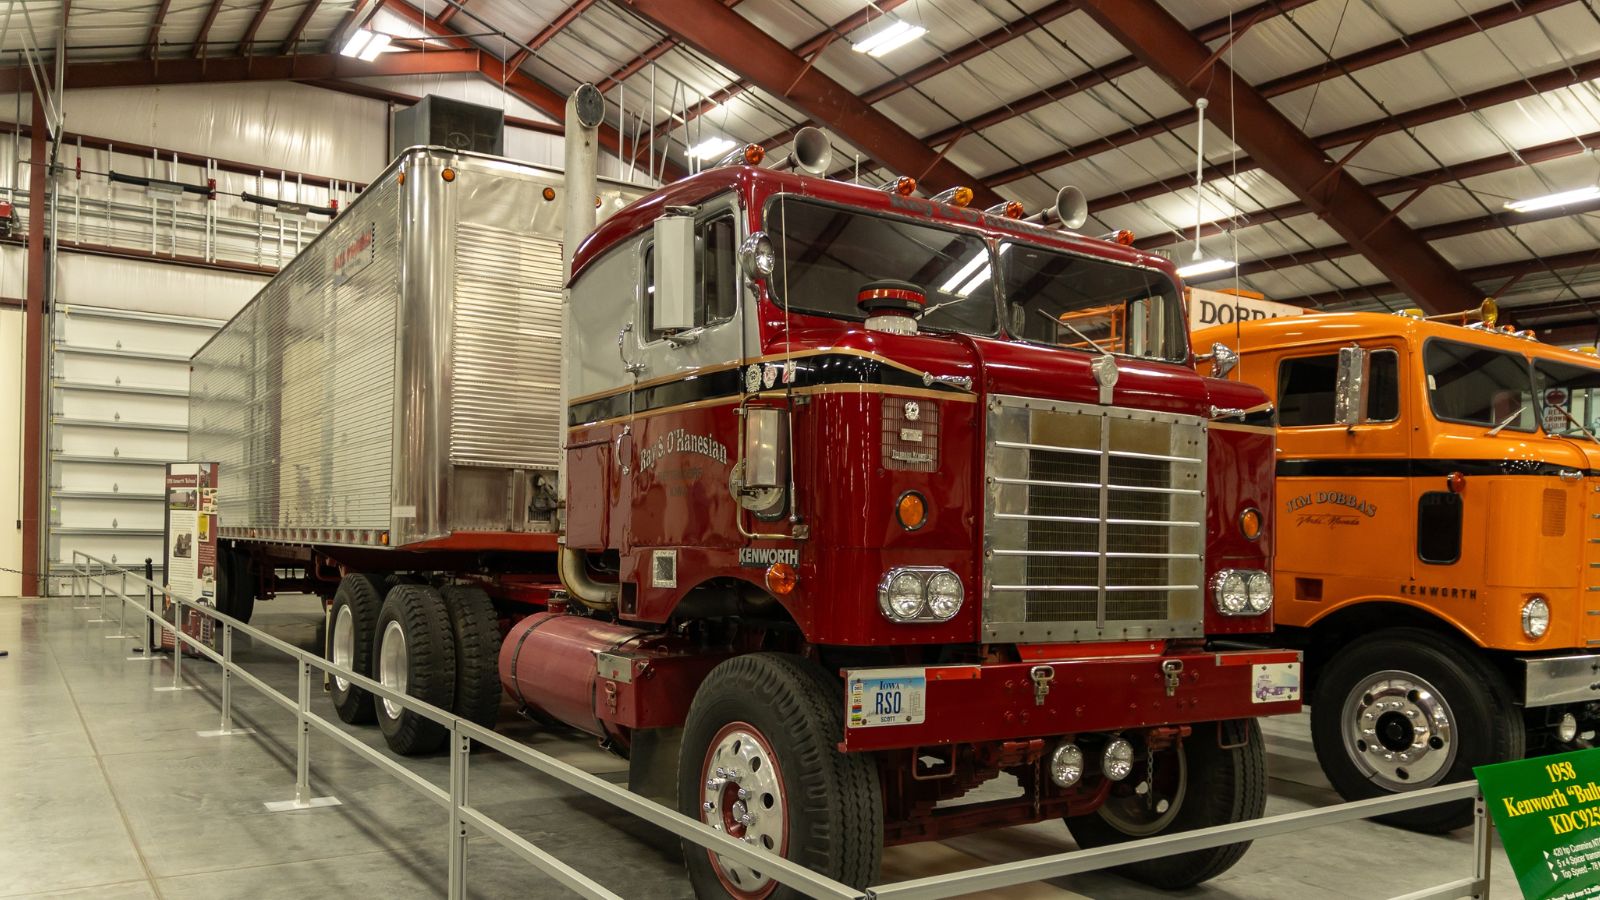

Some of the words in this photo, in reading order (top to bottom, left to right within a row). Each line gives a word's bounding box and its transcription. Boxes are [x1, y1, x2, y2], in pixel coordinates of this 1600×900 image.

[640, 444, 657, 473] Ray
[667, 428, 727, 465] O'Hanesian
[1286, 493, 1313, 513] JIM
[1315, 490, 1378, 518] DOBBAS
[739, 548, 799, 565] KENWORTH
[1400, 584, 1477, 600] KENWORTH
[876, 691, 902, 715] RSO
[1545, 761, 1576, 783] 1958
[1502, 788, 1569, 817] Kenworth
[1561, 869, 1572, 880] Top
[1570, 864, 1588, 878] Speed
